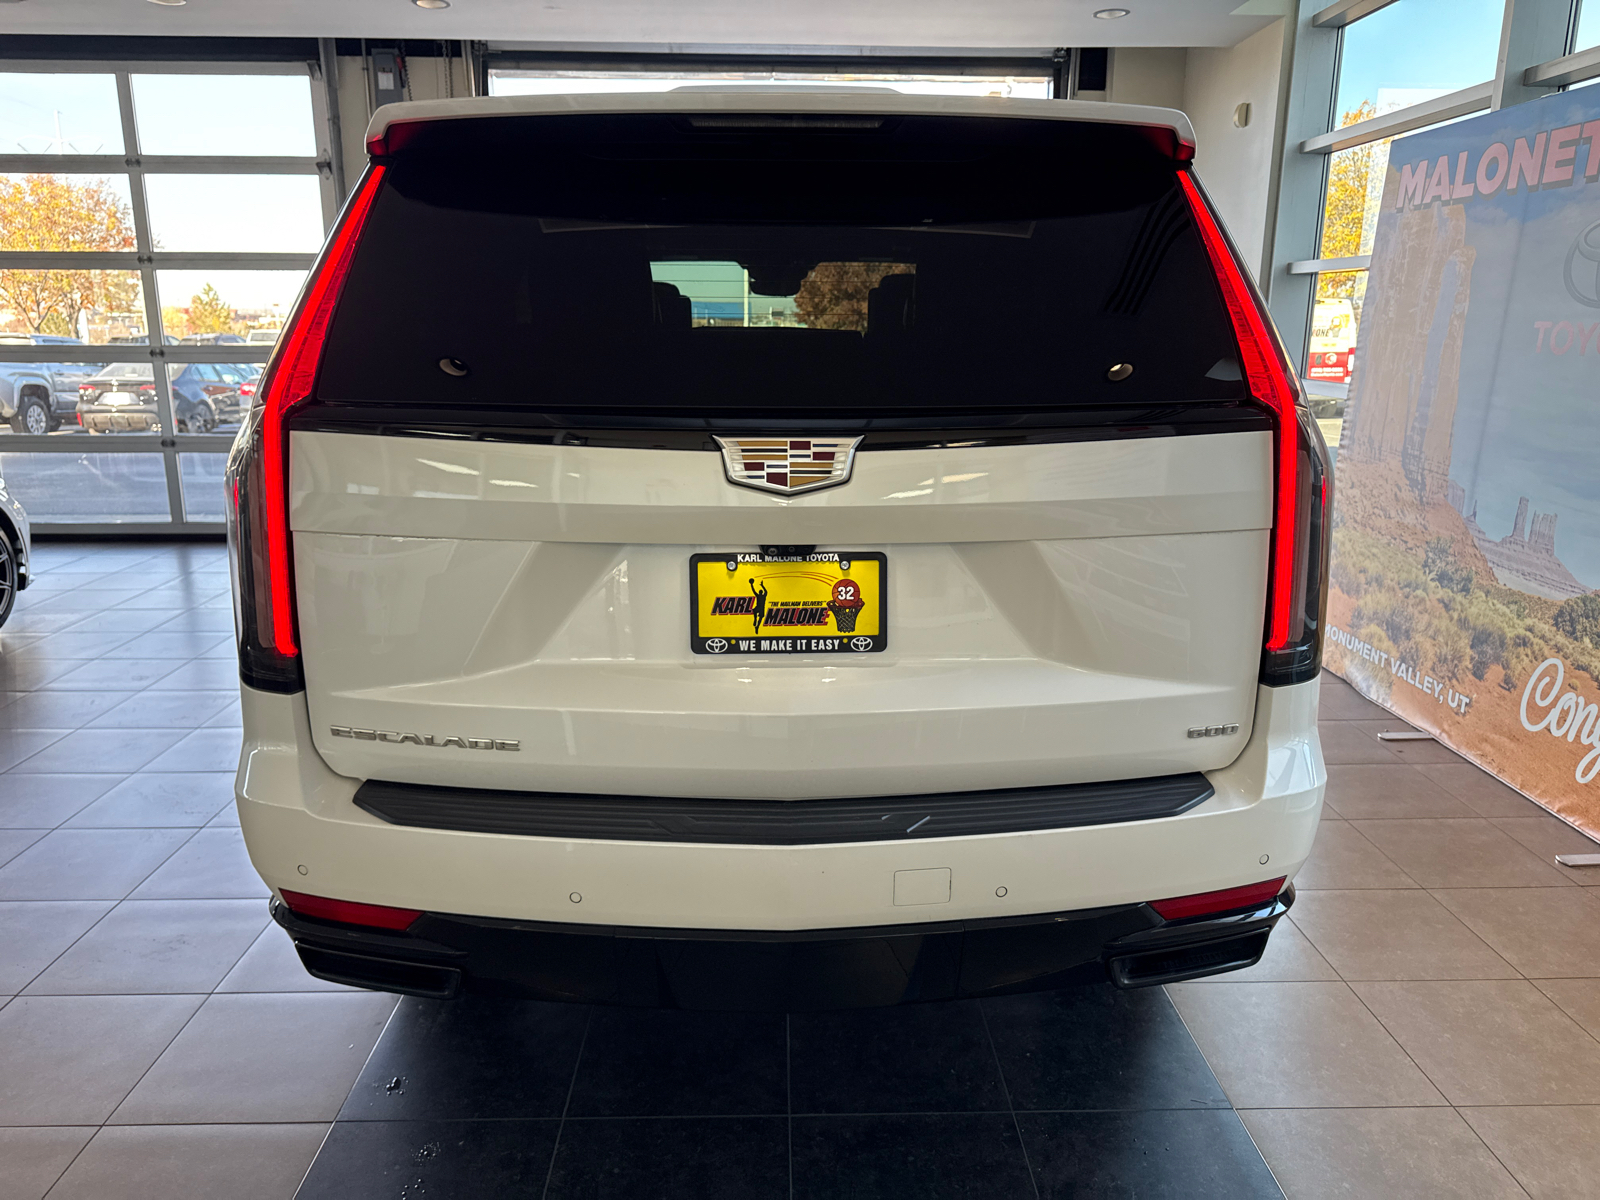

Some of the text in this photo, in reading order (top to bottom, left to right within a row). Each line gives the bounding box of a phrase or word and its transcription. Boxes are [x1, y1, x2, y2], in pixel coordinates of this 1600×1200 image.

[1534, 320, 1600, 356] TOY
[737, 554, 762, 562] KARL
[806, 554, 839, 562] TOYOTA
[838, 586, 854, 600] 32
[711, 596, 754, 615] KARL
[763, 607, 829, 626] MALONE
[739, 639, 840, 651] WE MAKE IT EASY
[1325, 623, 1470, 713] MONUMENT VALLEY, UT
[330, 724, 521, 752] ESCALADE
[1187, 723, 1239, 738] 600
